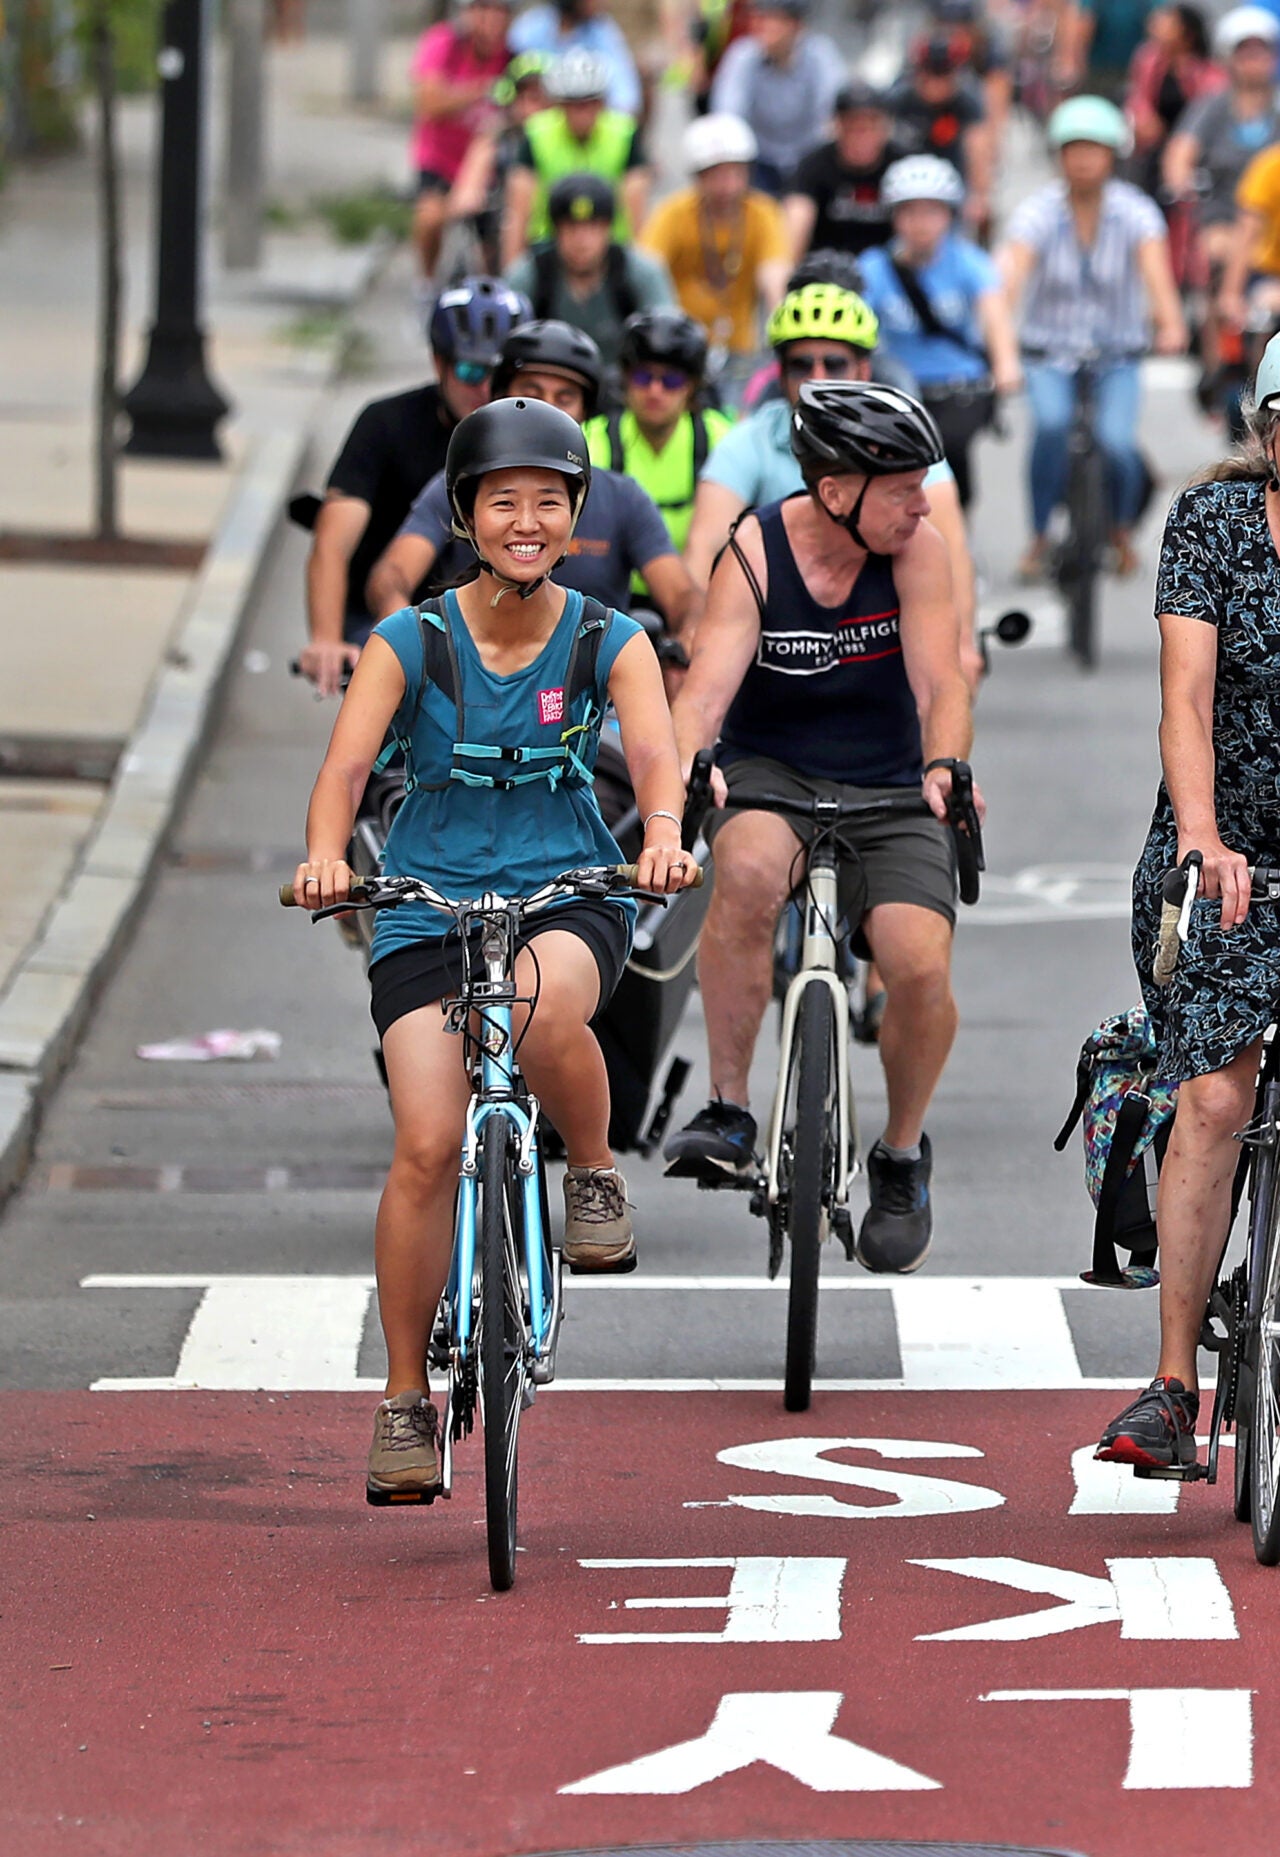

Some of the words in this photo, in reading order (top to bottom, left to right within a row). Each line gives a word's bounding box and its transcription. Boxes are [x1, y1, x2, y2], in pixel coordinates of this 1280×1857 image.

[766, 639, 832, 656] TOMMY
[833, 619, 899, 646] HILFIGE
[839, 642, 866, 656] 1985
